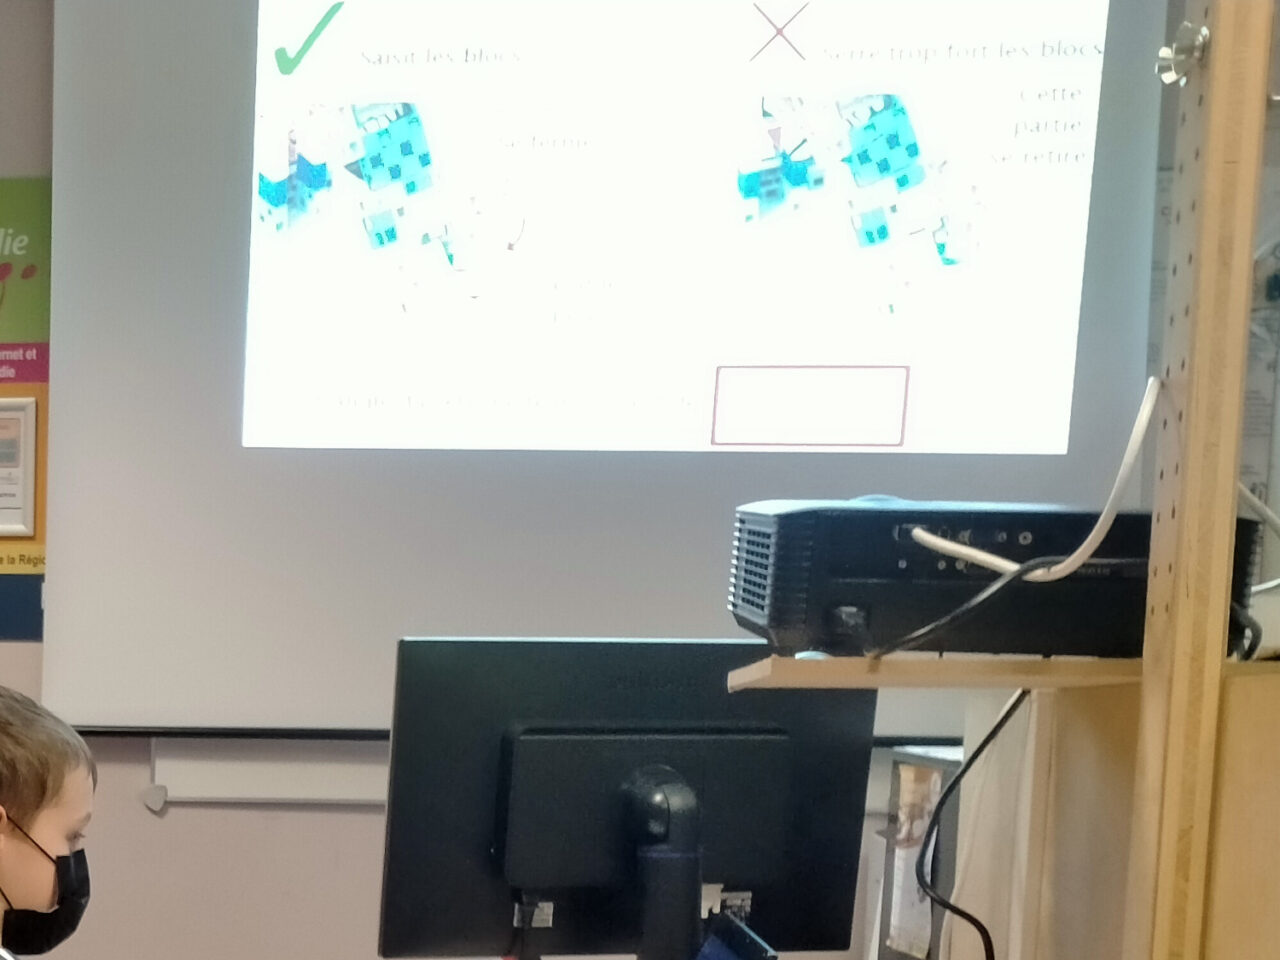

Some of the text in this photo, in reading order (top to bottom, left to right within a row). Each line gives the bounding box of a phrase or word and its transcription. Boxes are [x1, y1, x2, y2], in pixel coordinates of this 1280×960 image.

[999, 42, 1029, 58] les
[1041, 41, 1104, 58] blocs
[26, 348, 37, 360] et
[7, 555, 16, 565] la
